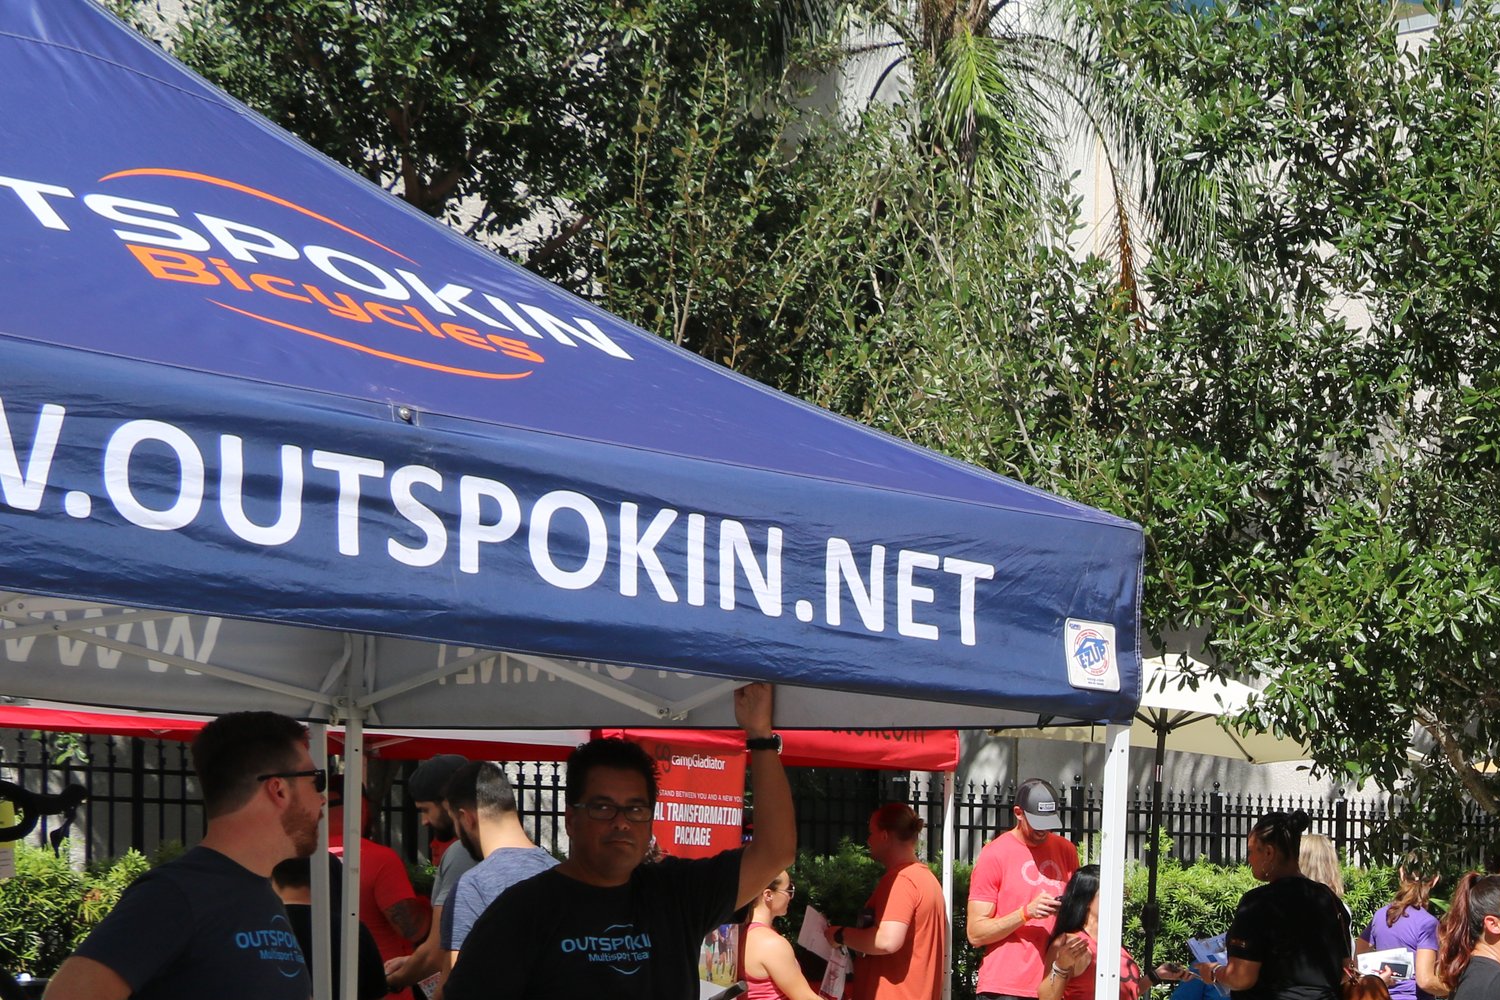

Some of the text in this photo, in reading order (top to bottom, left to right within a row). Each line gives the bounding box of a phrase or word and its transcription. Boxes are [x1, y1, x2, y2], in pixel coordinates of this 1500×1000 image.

[126, 244, 545, 364] Bicycles
[671, 754, 725, 770] campGladiator
[659, 789, 675, 797] STAND
[675, 791, 697, 799] BETWEEN
[708, 793, 718, 801] AND
[666, 802, 743, 826] TRANSFORMATION
[674, 825, 712, 846] PACKAGE
